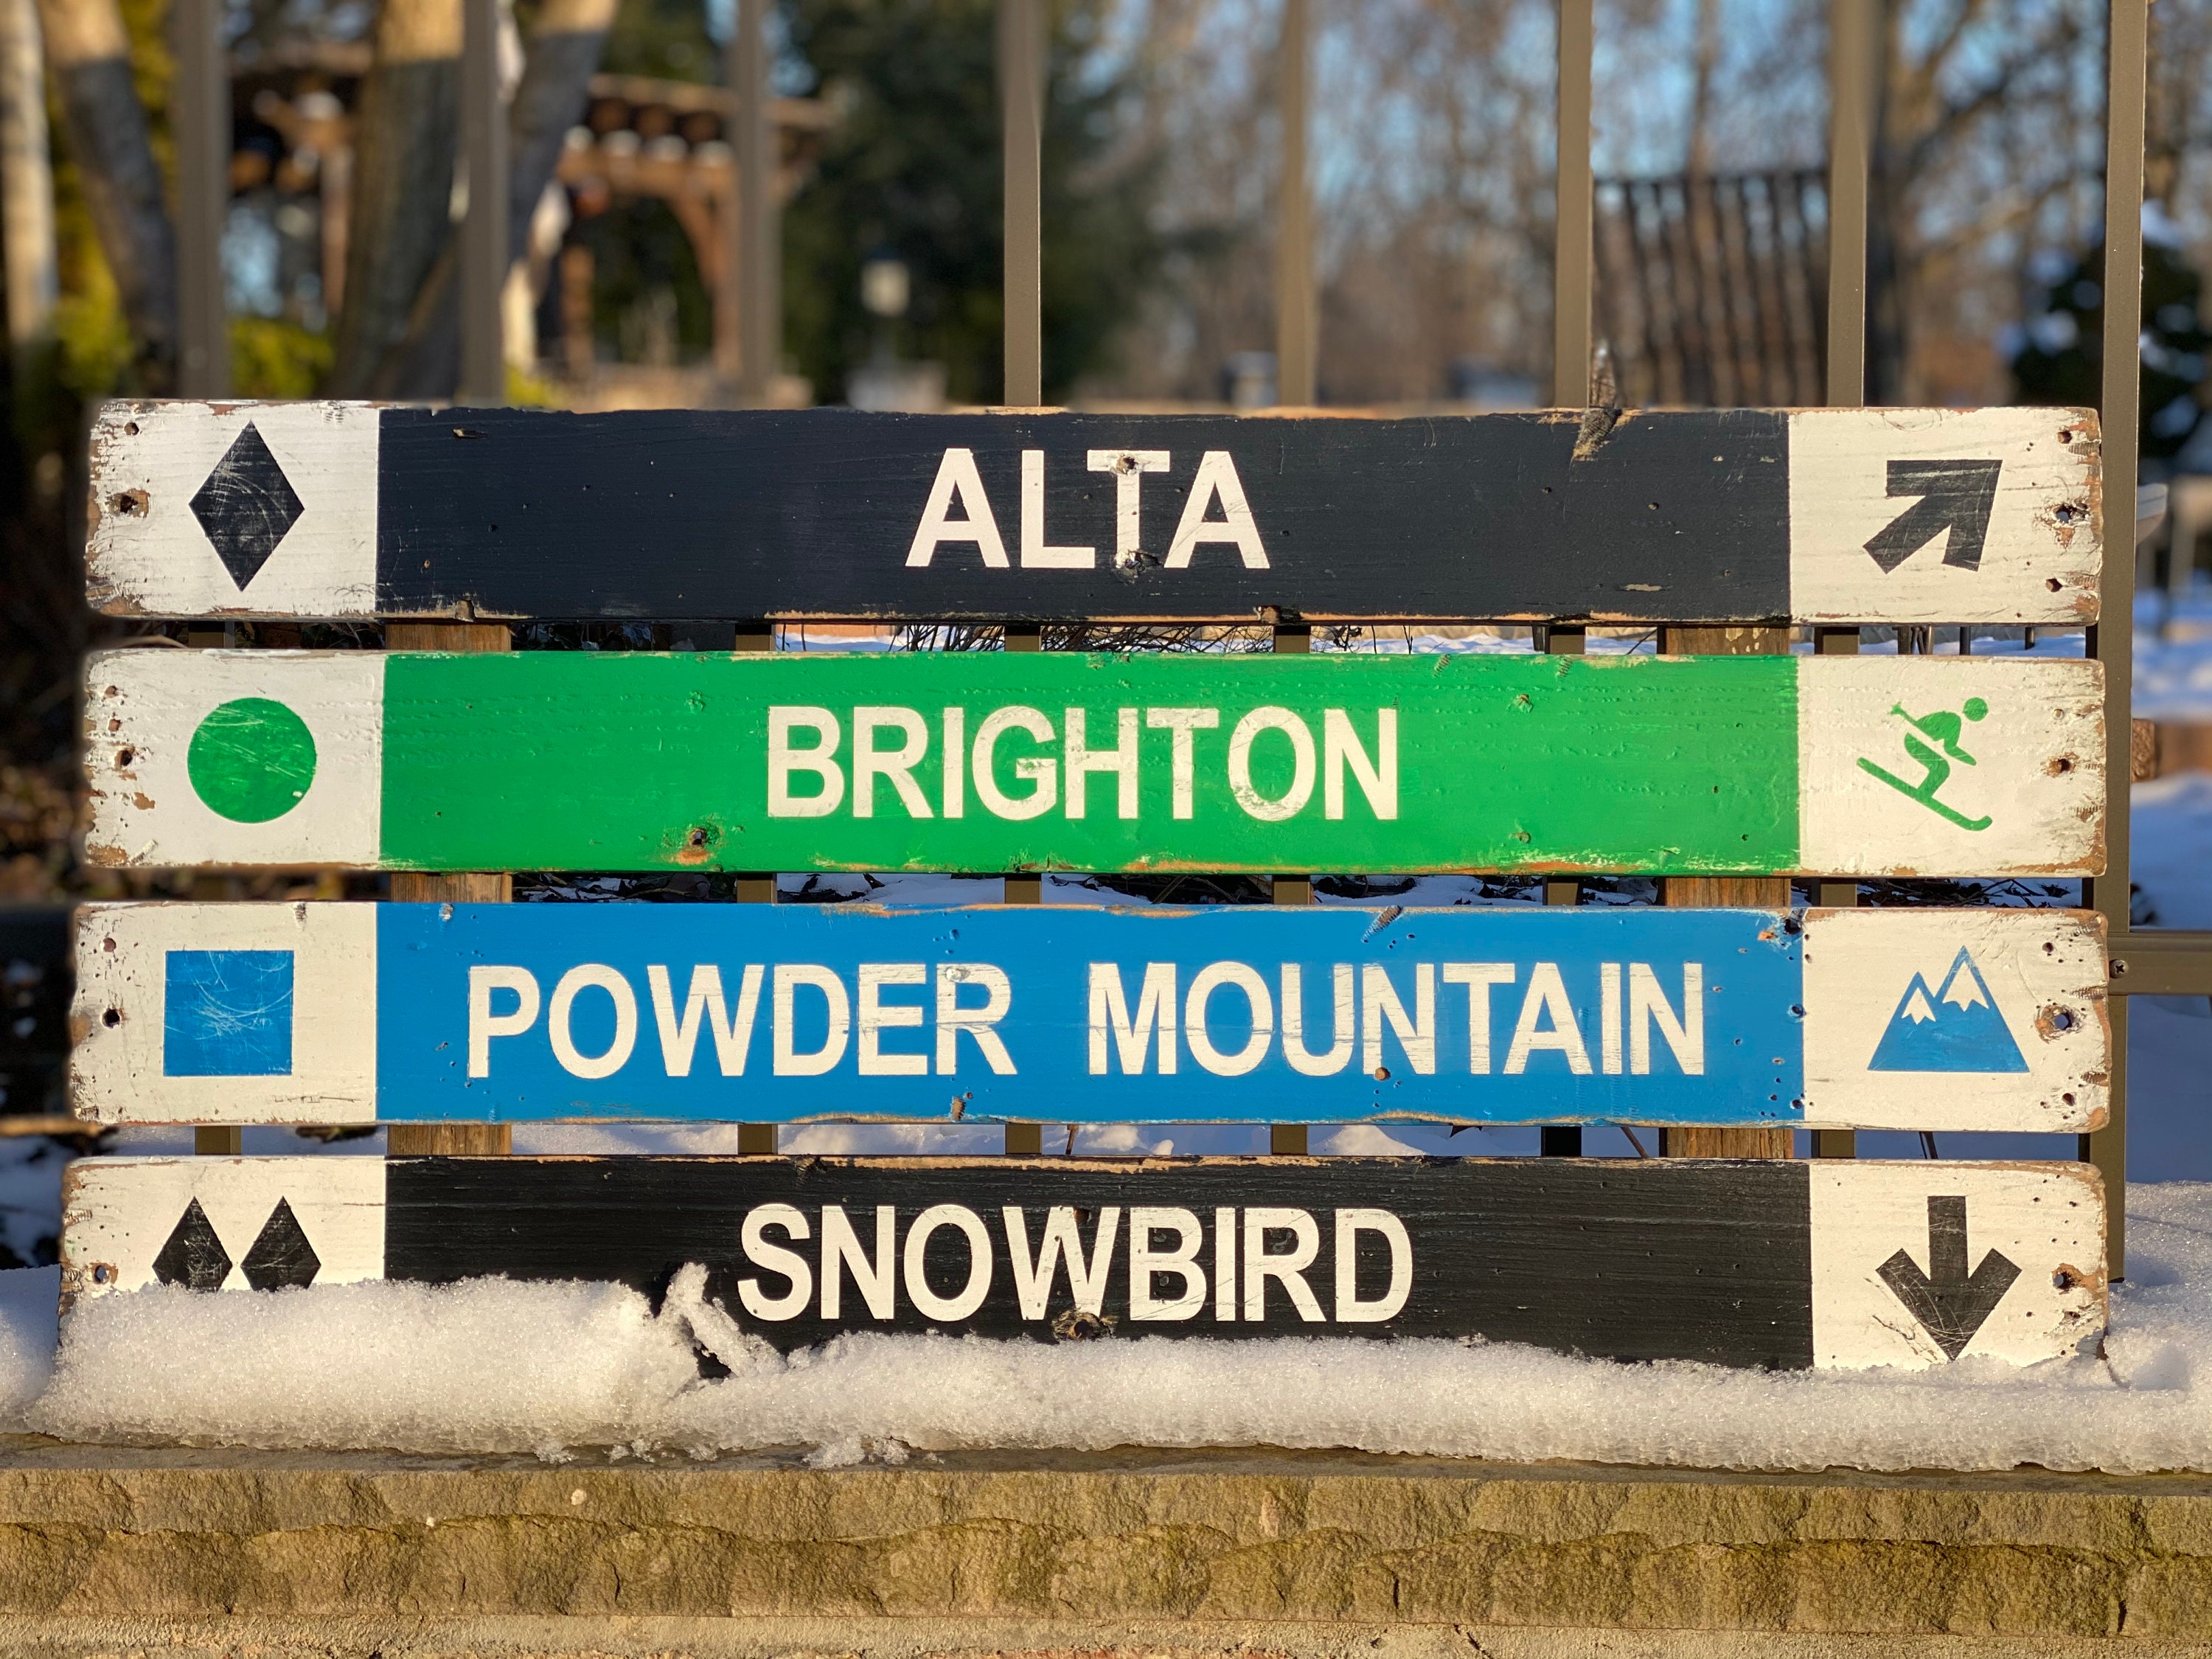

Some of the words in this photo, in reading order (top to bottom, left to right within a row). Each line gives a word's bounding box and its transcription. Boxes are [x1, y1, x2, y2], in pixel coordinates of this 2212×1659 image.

[905, 448, 1270, 570] ALTA
[768, 705, 1398, 821] BRIGHTON
[467, 963, 1018, 1079] POWDER
[1088, 961, 1705, 1079] MOUNTAIN
[737, 1203, 1413, 1324] SNOWBIRD
